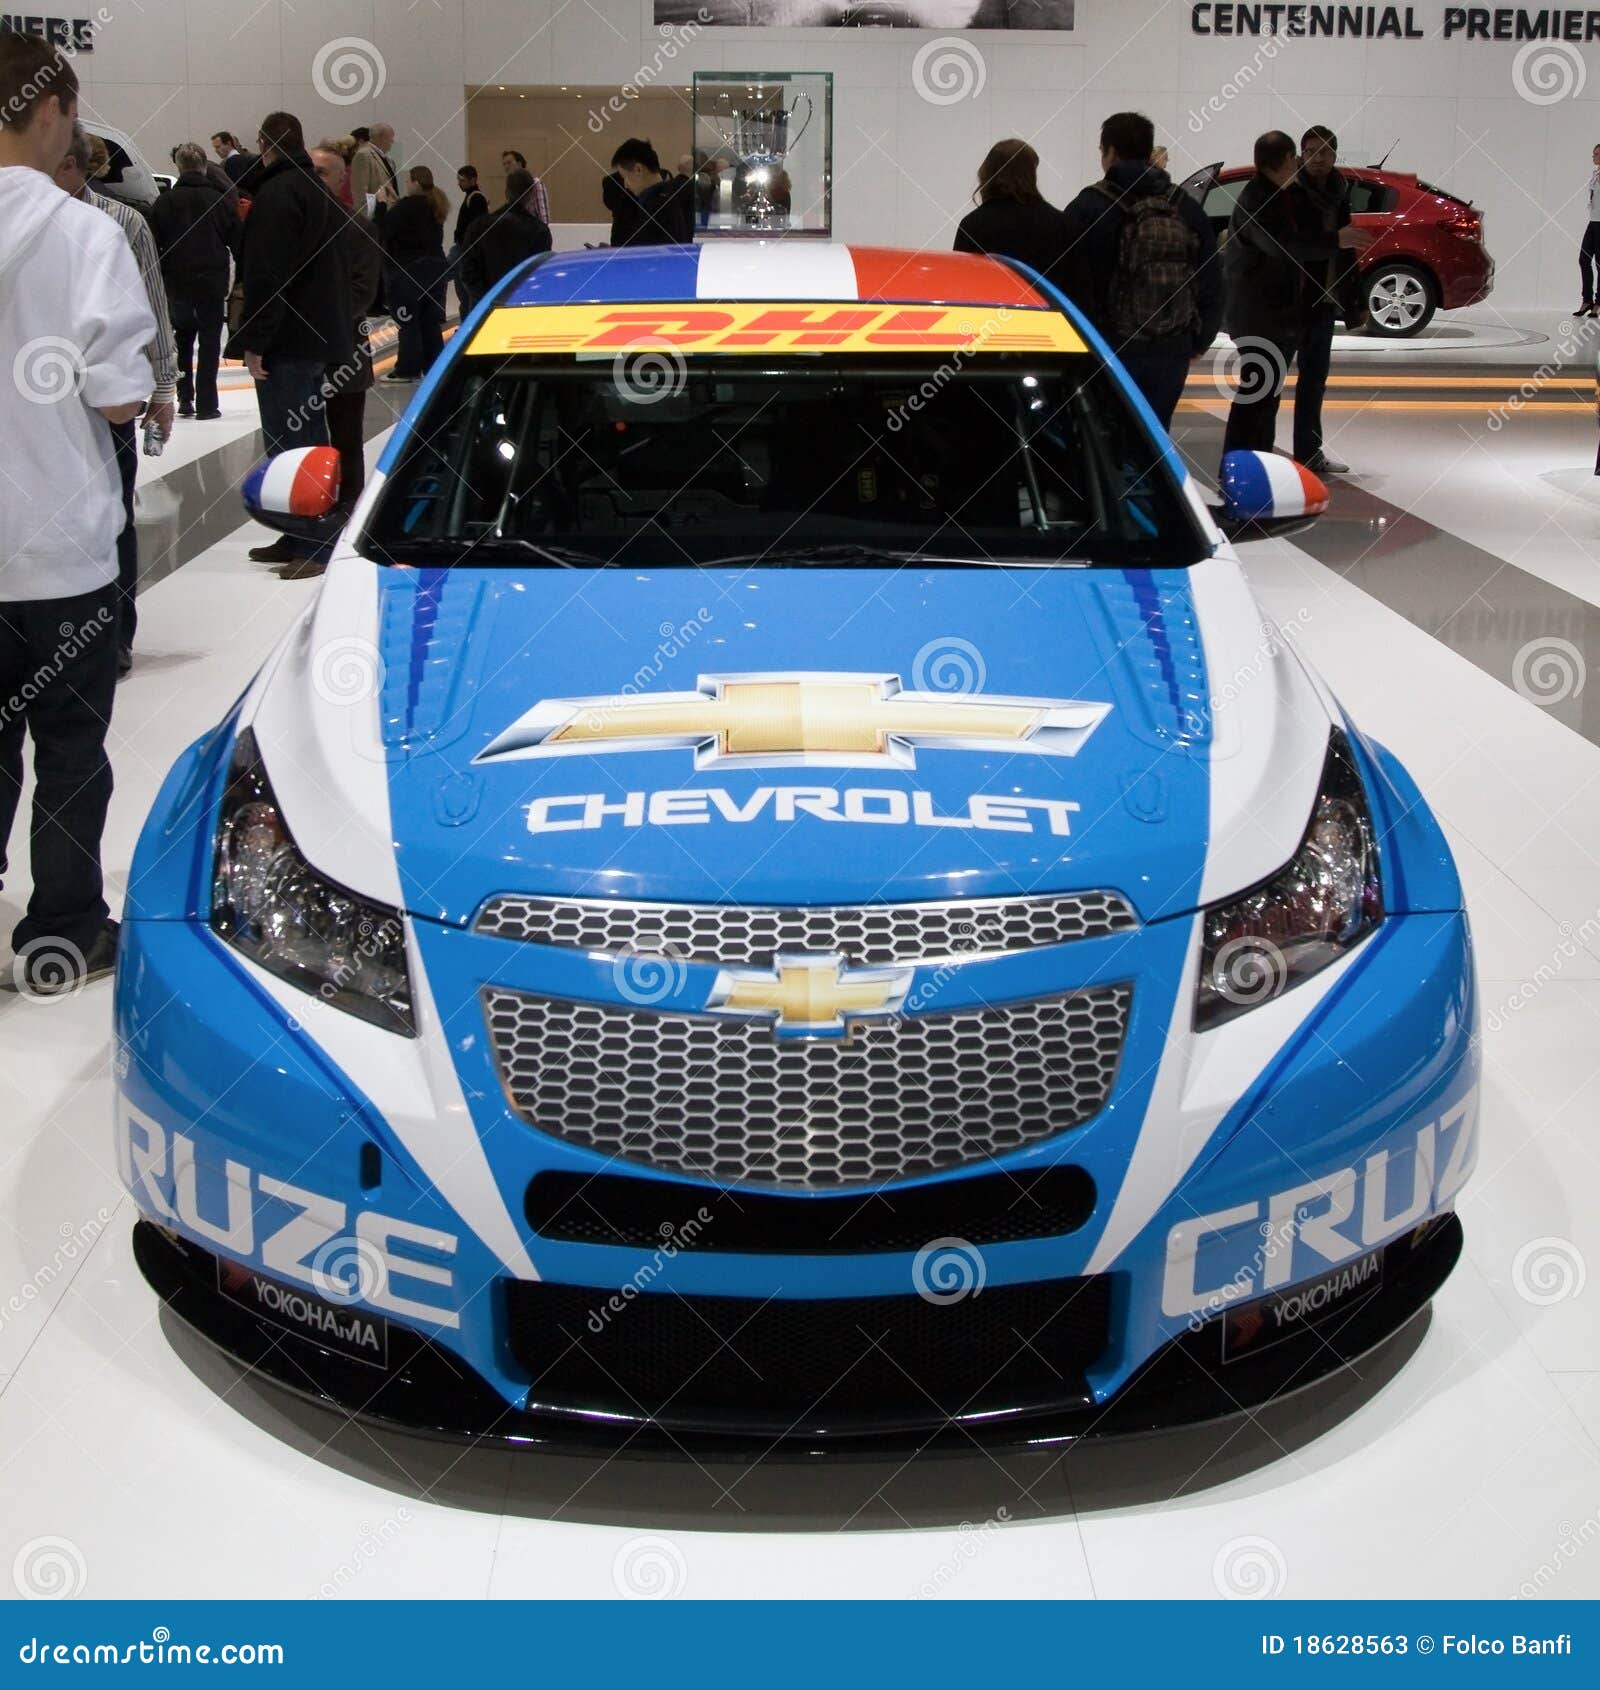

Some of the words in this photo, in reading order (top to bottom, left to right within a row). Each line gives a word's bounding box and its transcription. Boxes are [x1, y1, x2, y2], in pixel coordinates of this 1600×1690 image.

[0, 14, 94, 51] IERE
[1191, 3, 1423, 37] CENTENNIAL
[1443, 8, 1600, 41] PREMIER
[580, 310, 979, 346] DHL
[527, 786, 1081, 836] CHEVROLET
[1161, 1086, 1479, 1317] CRUZ
[253, 1276, 380, 1351] YOKOHAMA
[1274, 1253, 1379, 1327] YOKOHAMA
